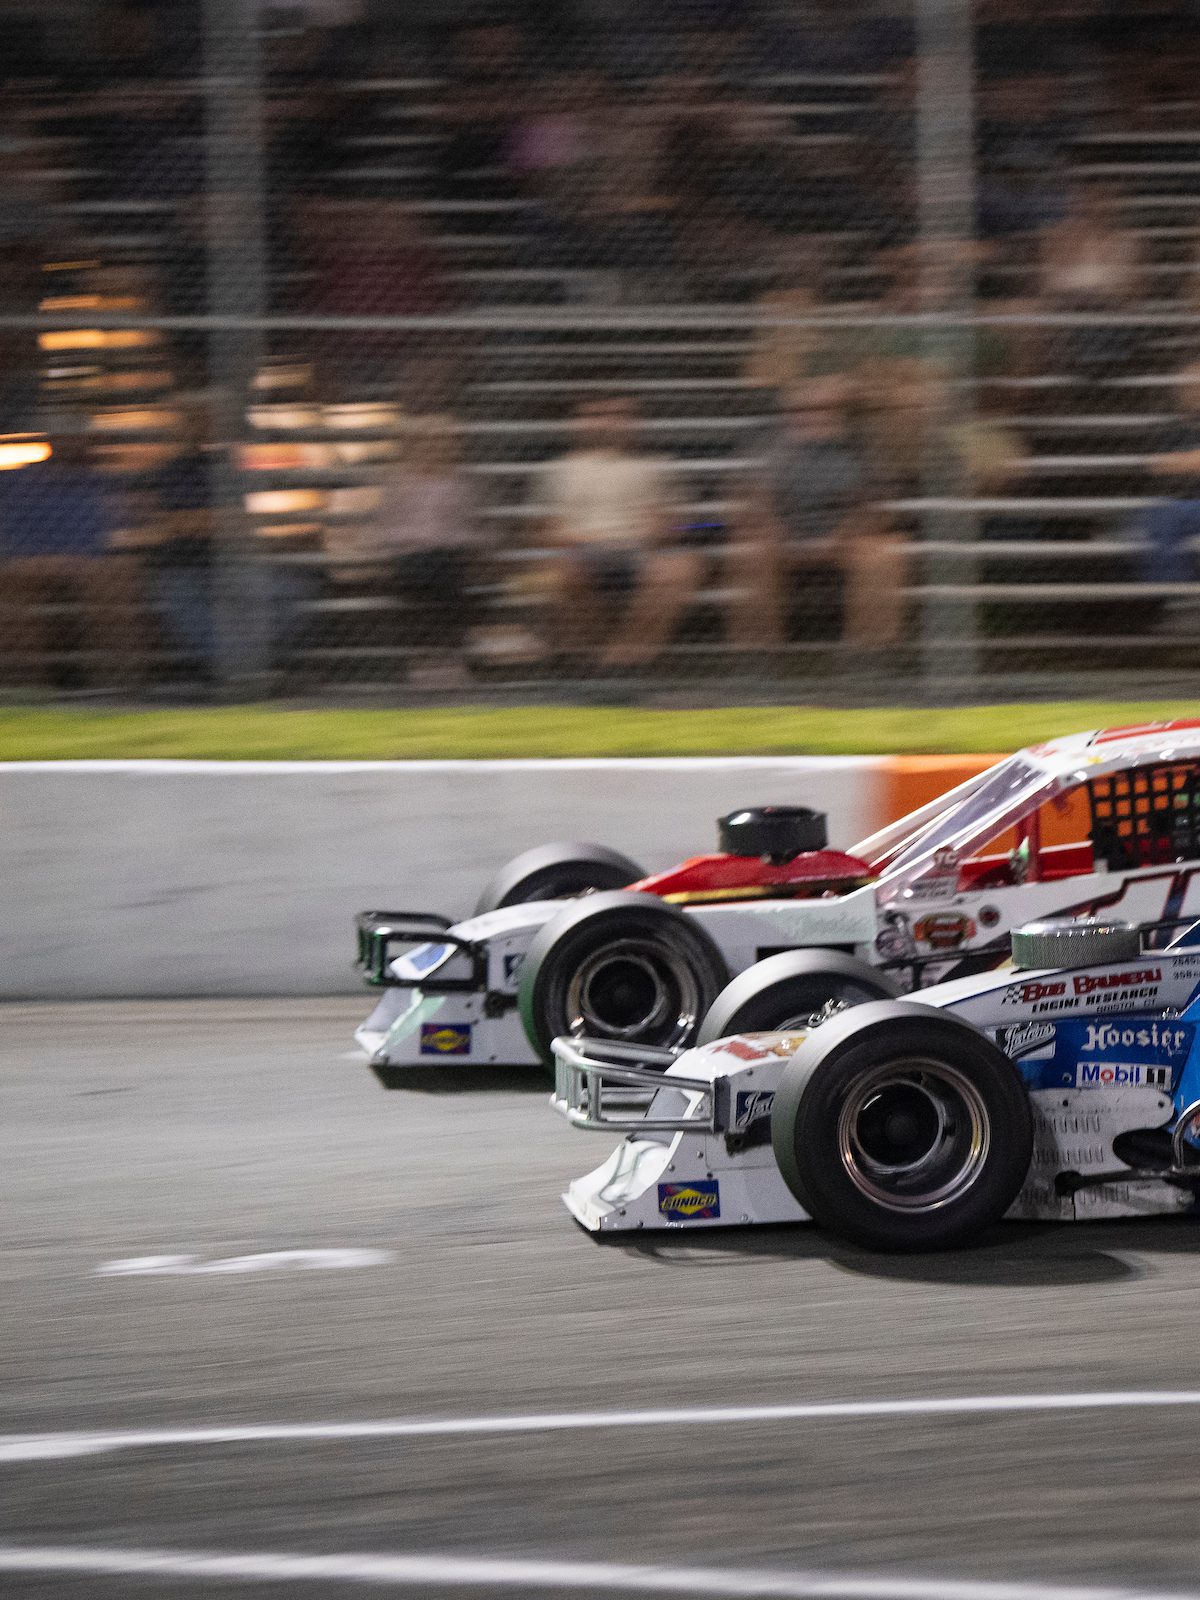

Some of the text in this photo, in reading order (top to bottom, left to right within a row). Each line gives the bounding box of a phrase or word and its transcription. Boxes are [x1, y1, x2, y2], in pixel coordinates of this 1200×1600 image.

[1023, 982, 1067, 1004] BOB
[1032, 986, 1159, 1014] ENGINE RESEARCH
[1081, 1022, 1186, 1051] Hoosier
[1082, 1065, 1140, 1083] Mobil
[661, 1193, 717, 1210] SUNOCO
